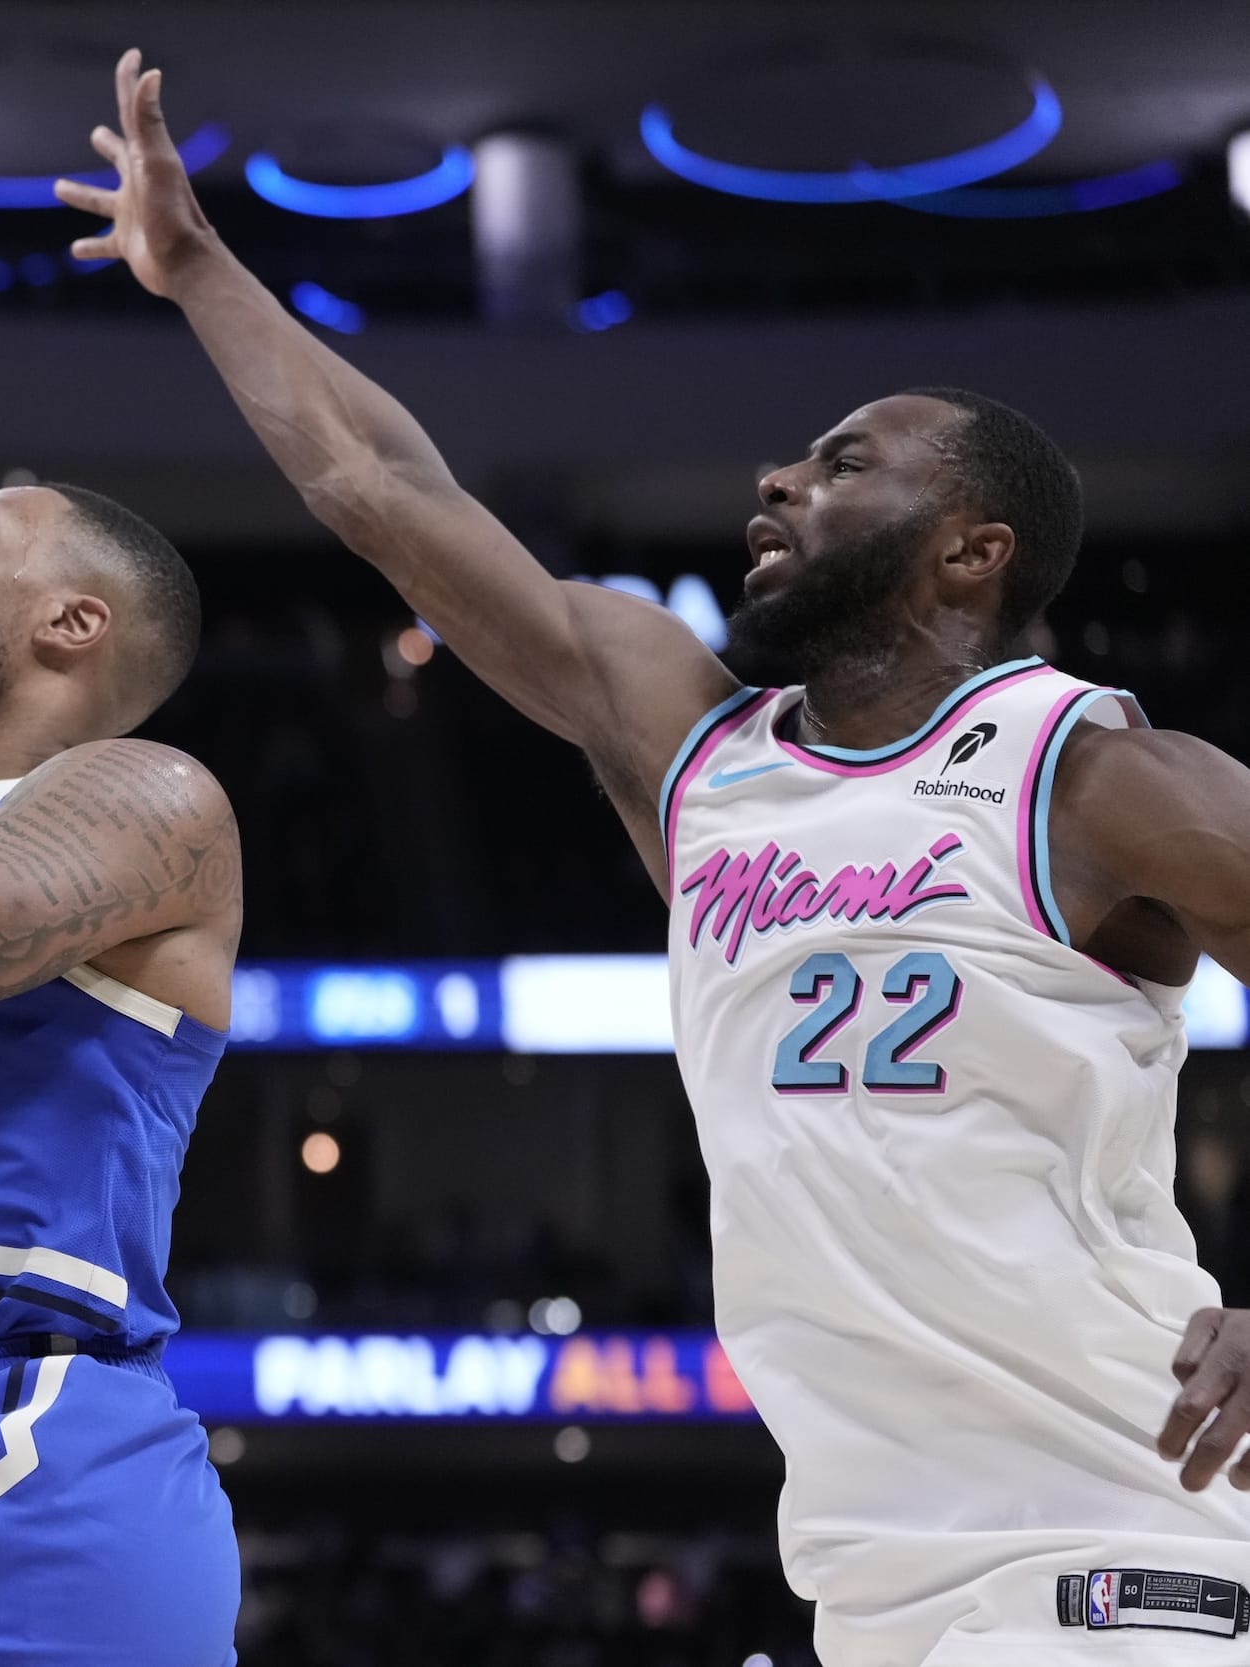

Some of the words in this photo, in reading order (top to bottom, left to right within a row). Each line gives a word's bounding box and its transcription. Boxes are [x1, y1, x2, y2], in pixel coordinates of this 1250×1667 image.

[913, 779, 1005, 804] Robinhood
[680, 832, 972, 966] Miami
[772, 952, 964, 1095] 22
[1124, 1584, 1138, 1596] 50
